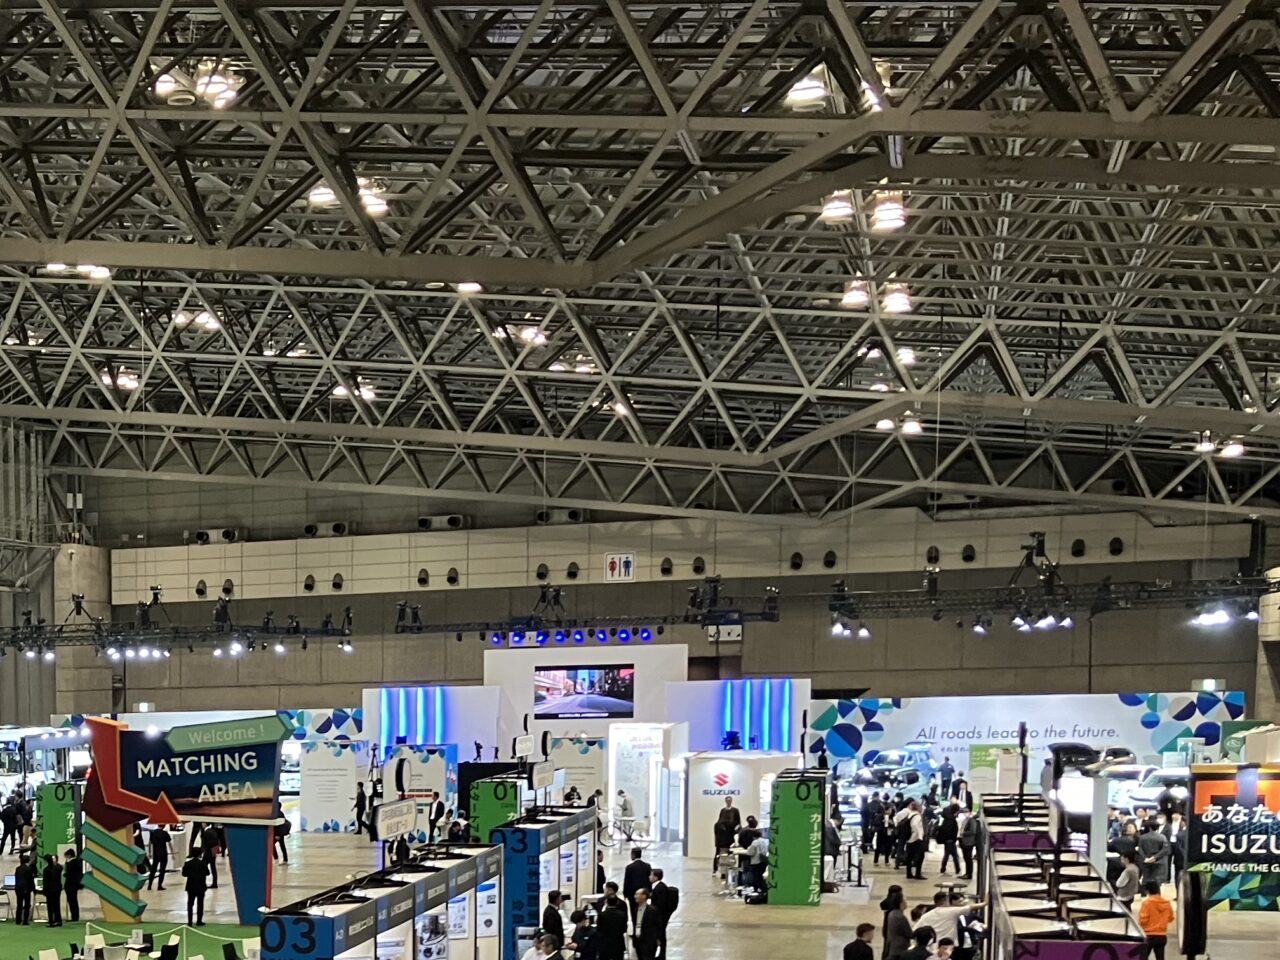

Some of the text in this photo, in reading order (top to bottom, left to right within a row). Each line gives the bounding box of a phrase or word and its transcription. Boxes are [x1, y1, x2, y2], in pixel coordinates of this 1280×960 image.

[188, 728, 256, 745] Welcome
[916, 726, 936, 740] All
[941, 725, 982, 740] roads
[1044, 724, 1067, 738] the
[1071, 724, 1120, 738] future.
[136, 751, 258, 779] MATCHING
[54, 785, 75, 802] 01
[197, 781, 258, 803] AREA
[1201, 803, 1280, 824] あなた
[808, 813, 822, 903] カーボンニュートラル
[1246, 863, 1270, 872] THE
[260, 917, 317, 955] 03
